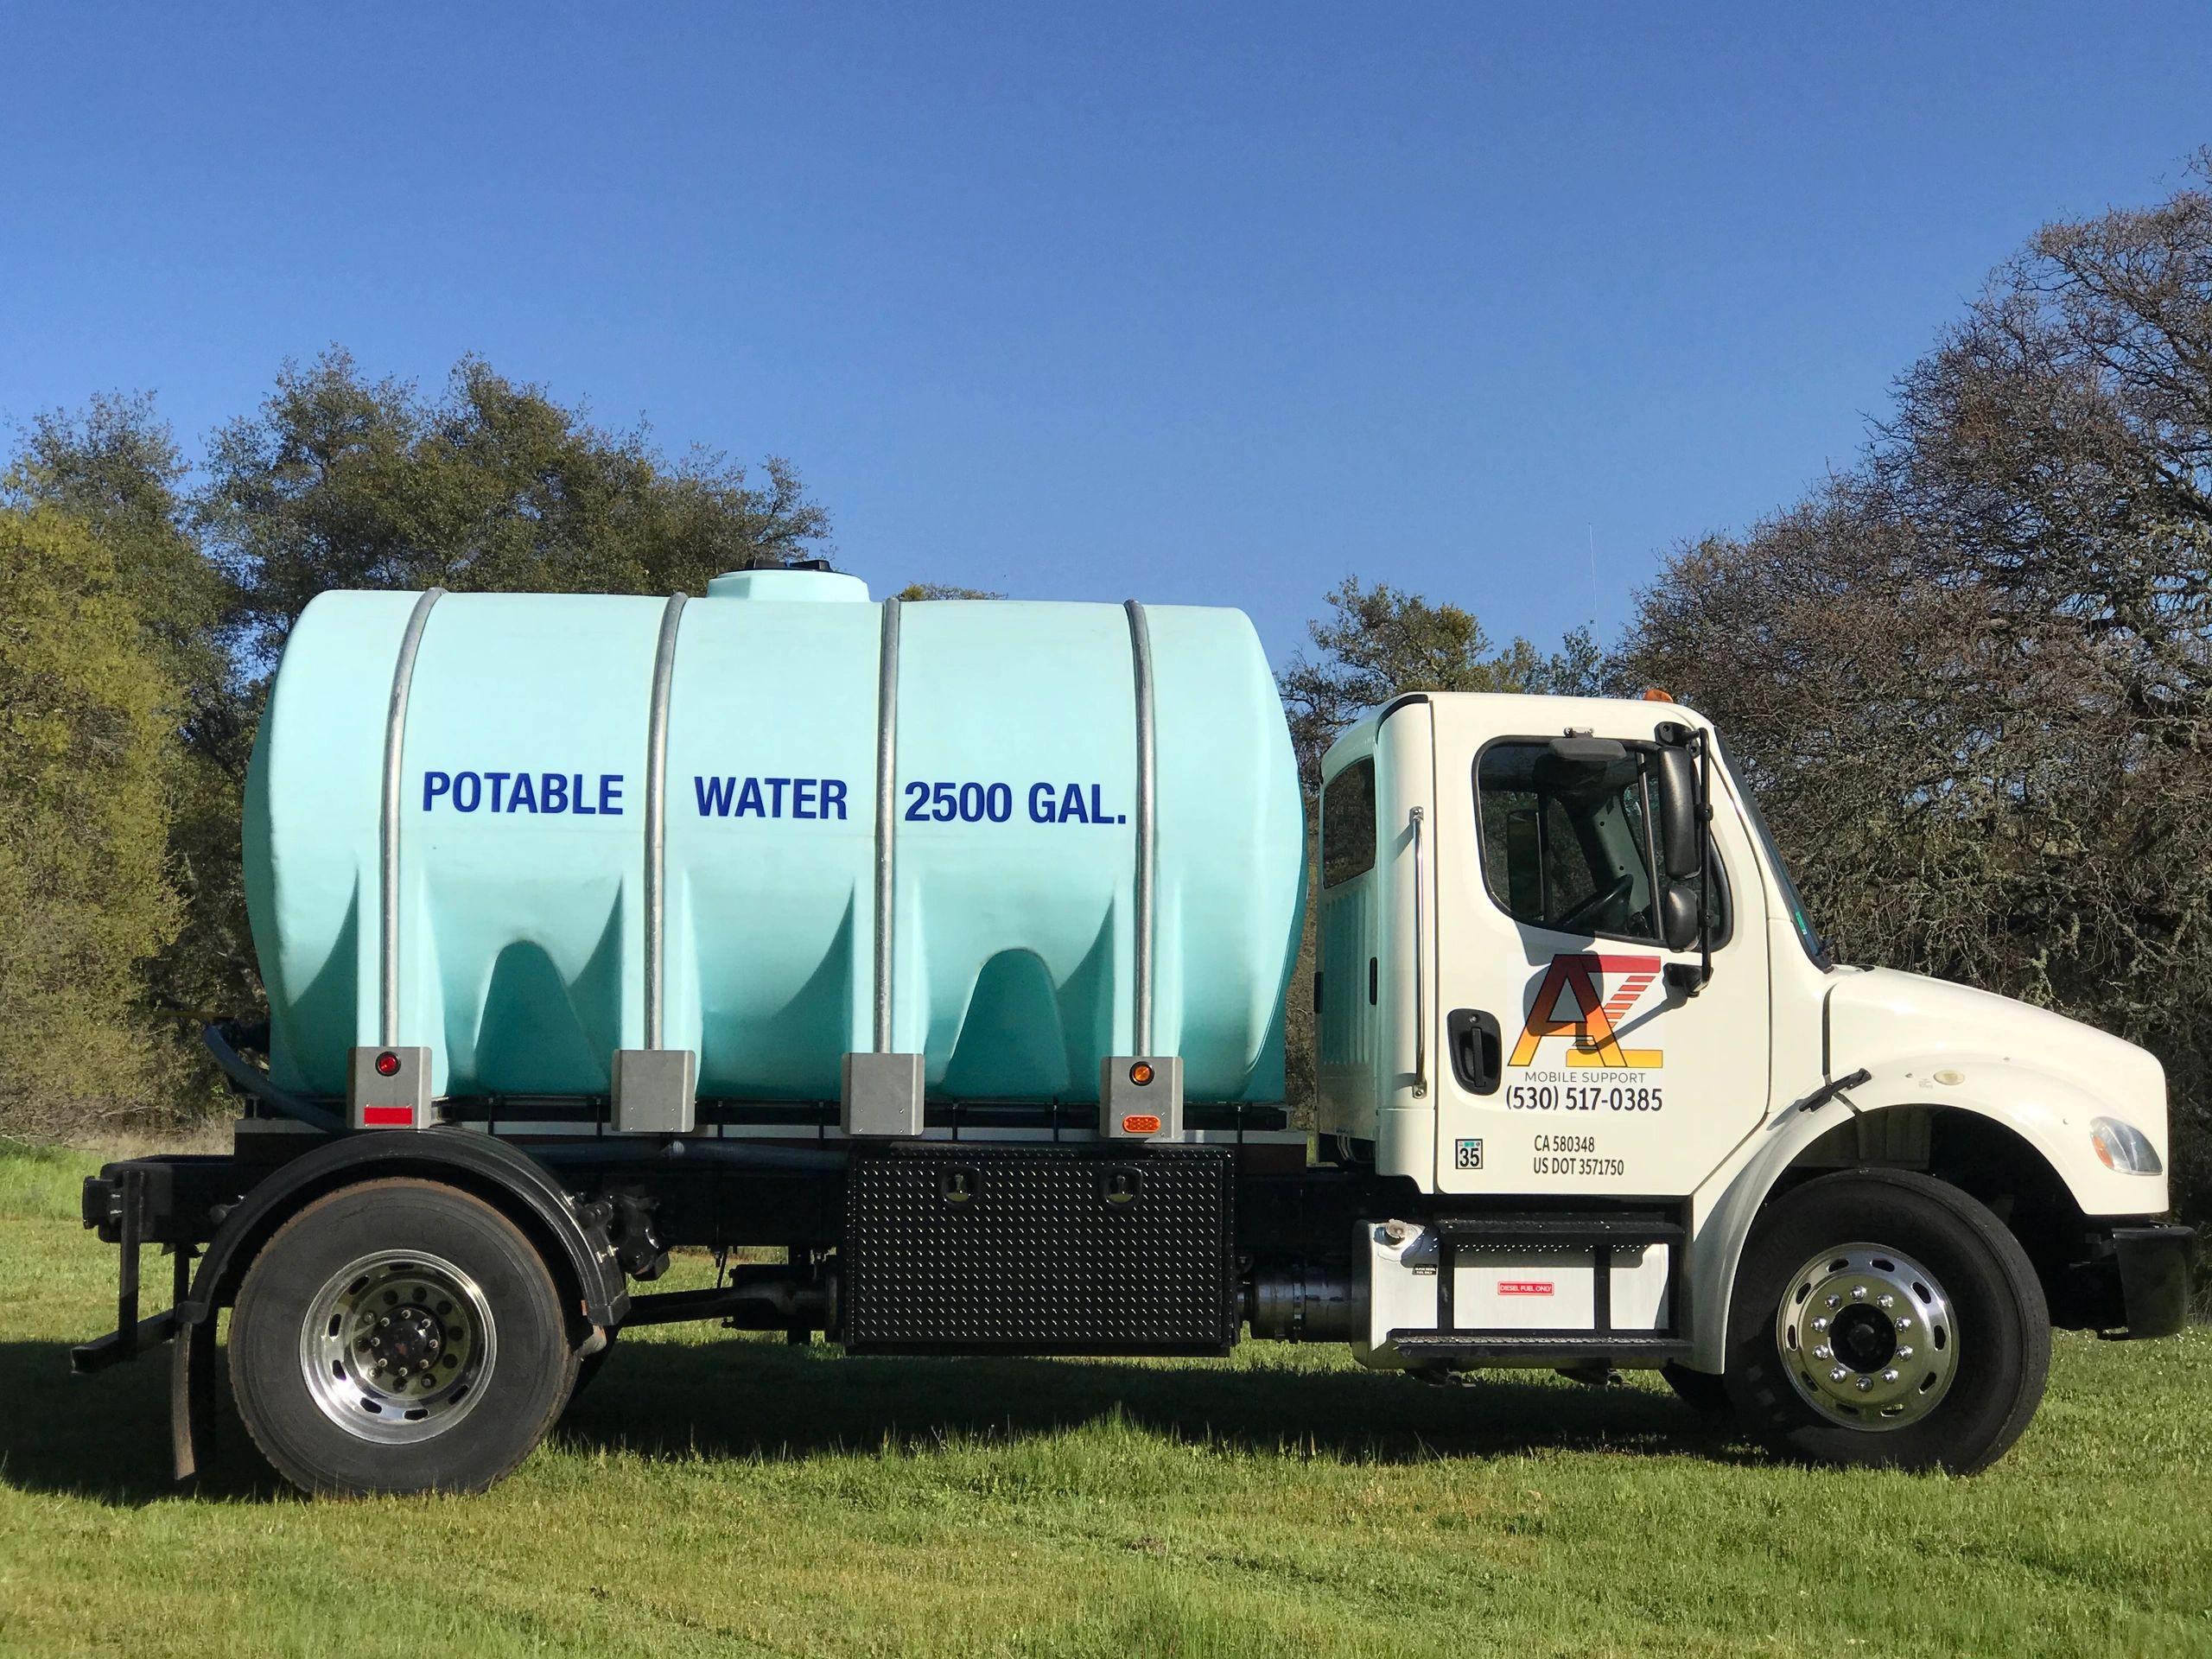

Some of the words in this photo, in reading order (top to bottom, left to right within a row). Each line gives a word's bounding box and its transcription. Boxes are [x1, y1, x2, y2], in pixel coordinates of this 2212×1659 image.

[423, 771, 624, 816] POTABLE
[694, 776, 849, 820] WATER
[904, 781, 1013, 823] 2500
[1028, 782, 1127, 824] GAL.
[1524, 1071, 1577, 1083] MOBILE
[1581, 1072, 1646, 1084] SUPPORT
[1506, 1085, 1559, 1111] (530)
[1565, 1087, 1662, 1112] 517-0385
[1534, 1135, 1550, 1152] CA
[1553, 1135, 1595, 1153] 580348
[1459, 1147, 1480, 1167] 35
[1533, 1157, 1549, 1174] US
[1552, 1157, 1577, 1175] DOT
[1579, 1158, 1624, 1176] 3571750
